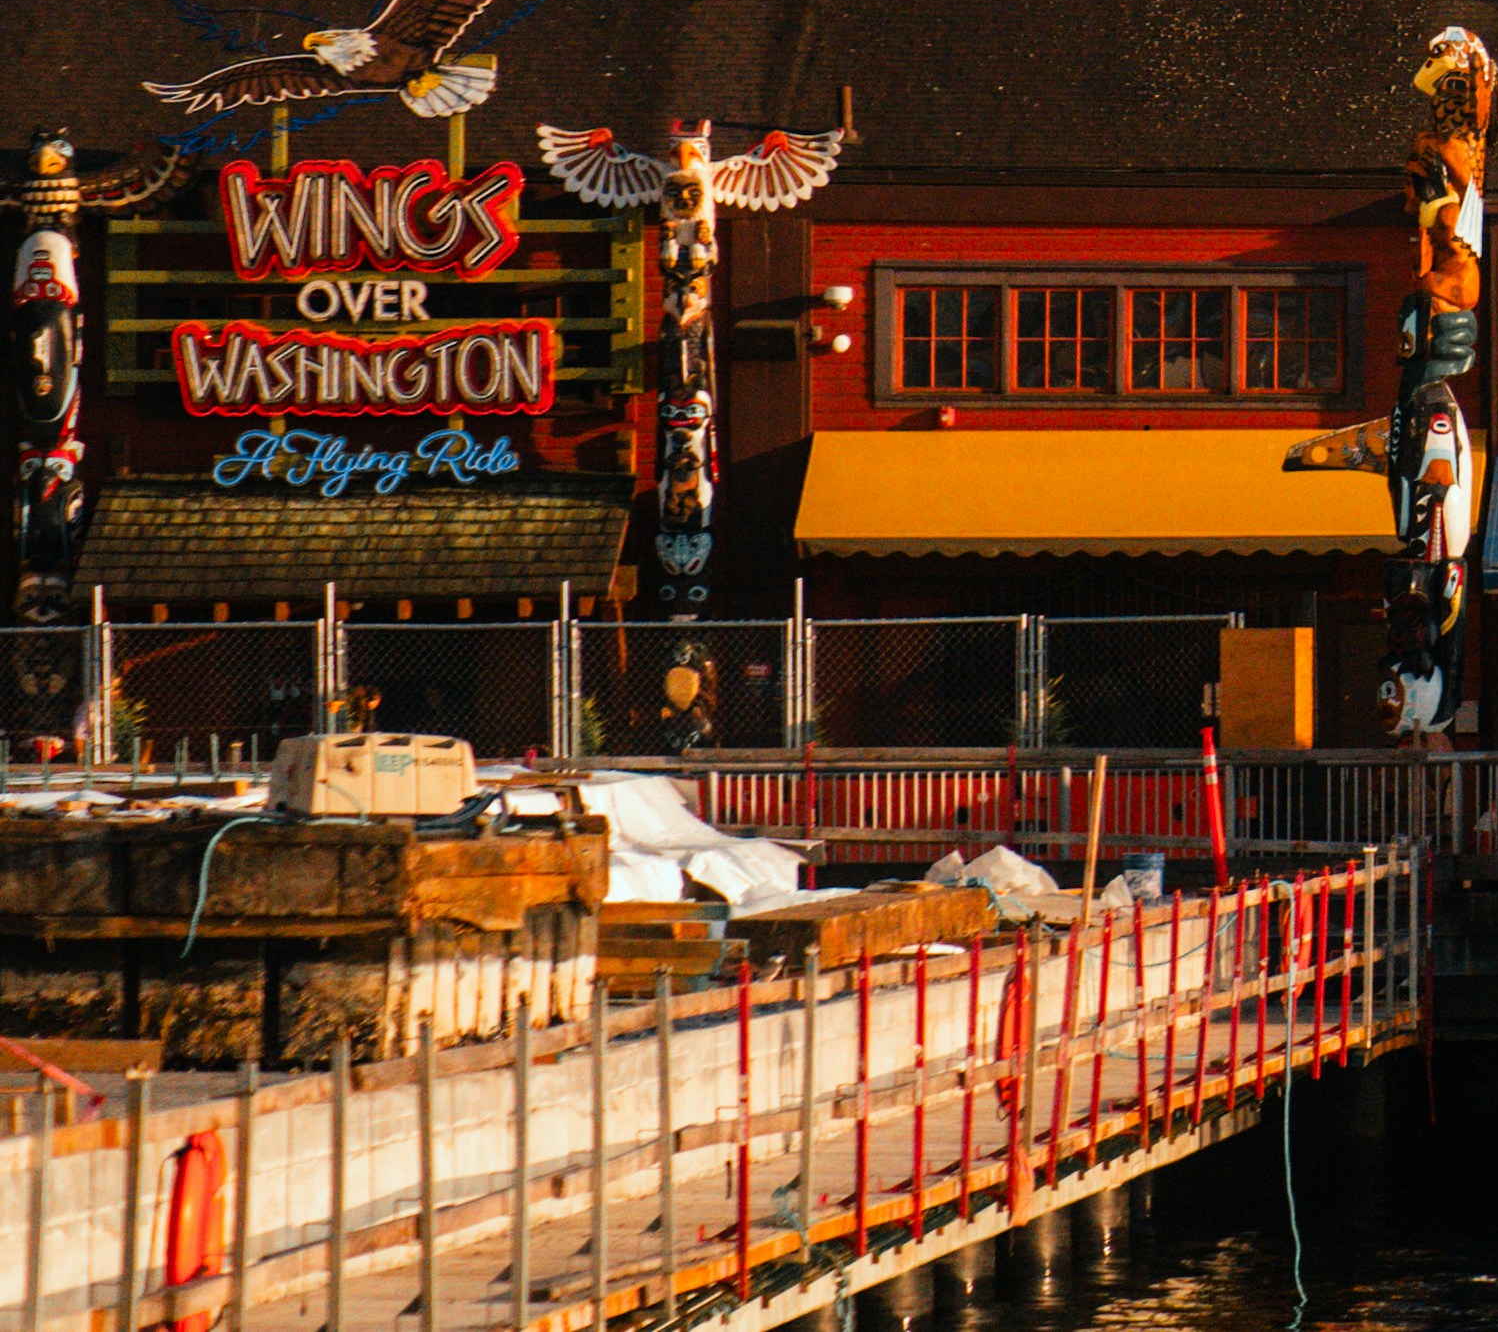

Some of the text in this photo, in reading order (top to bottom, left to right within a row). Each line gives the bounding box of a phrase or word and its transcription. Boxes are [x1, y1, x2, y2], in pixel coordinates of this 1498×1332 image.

[227, 171, 509, 269] WINGS
[297, 279, 431, 324] OVER
[180, 331, 542, 405] WASHINGTON
[214, 428, 520, 498] A Flying Ride
